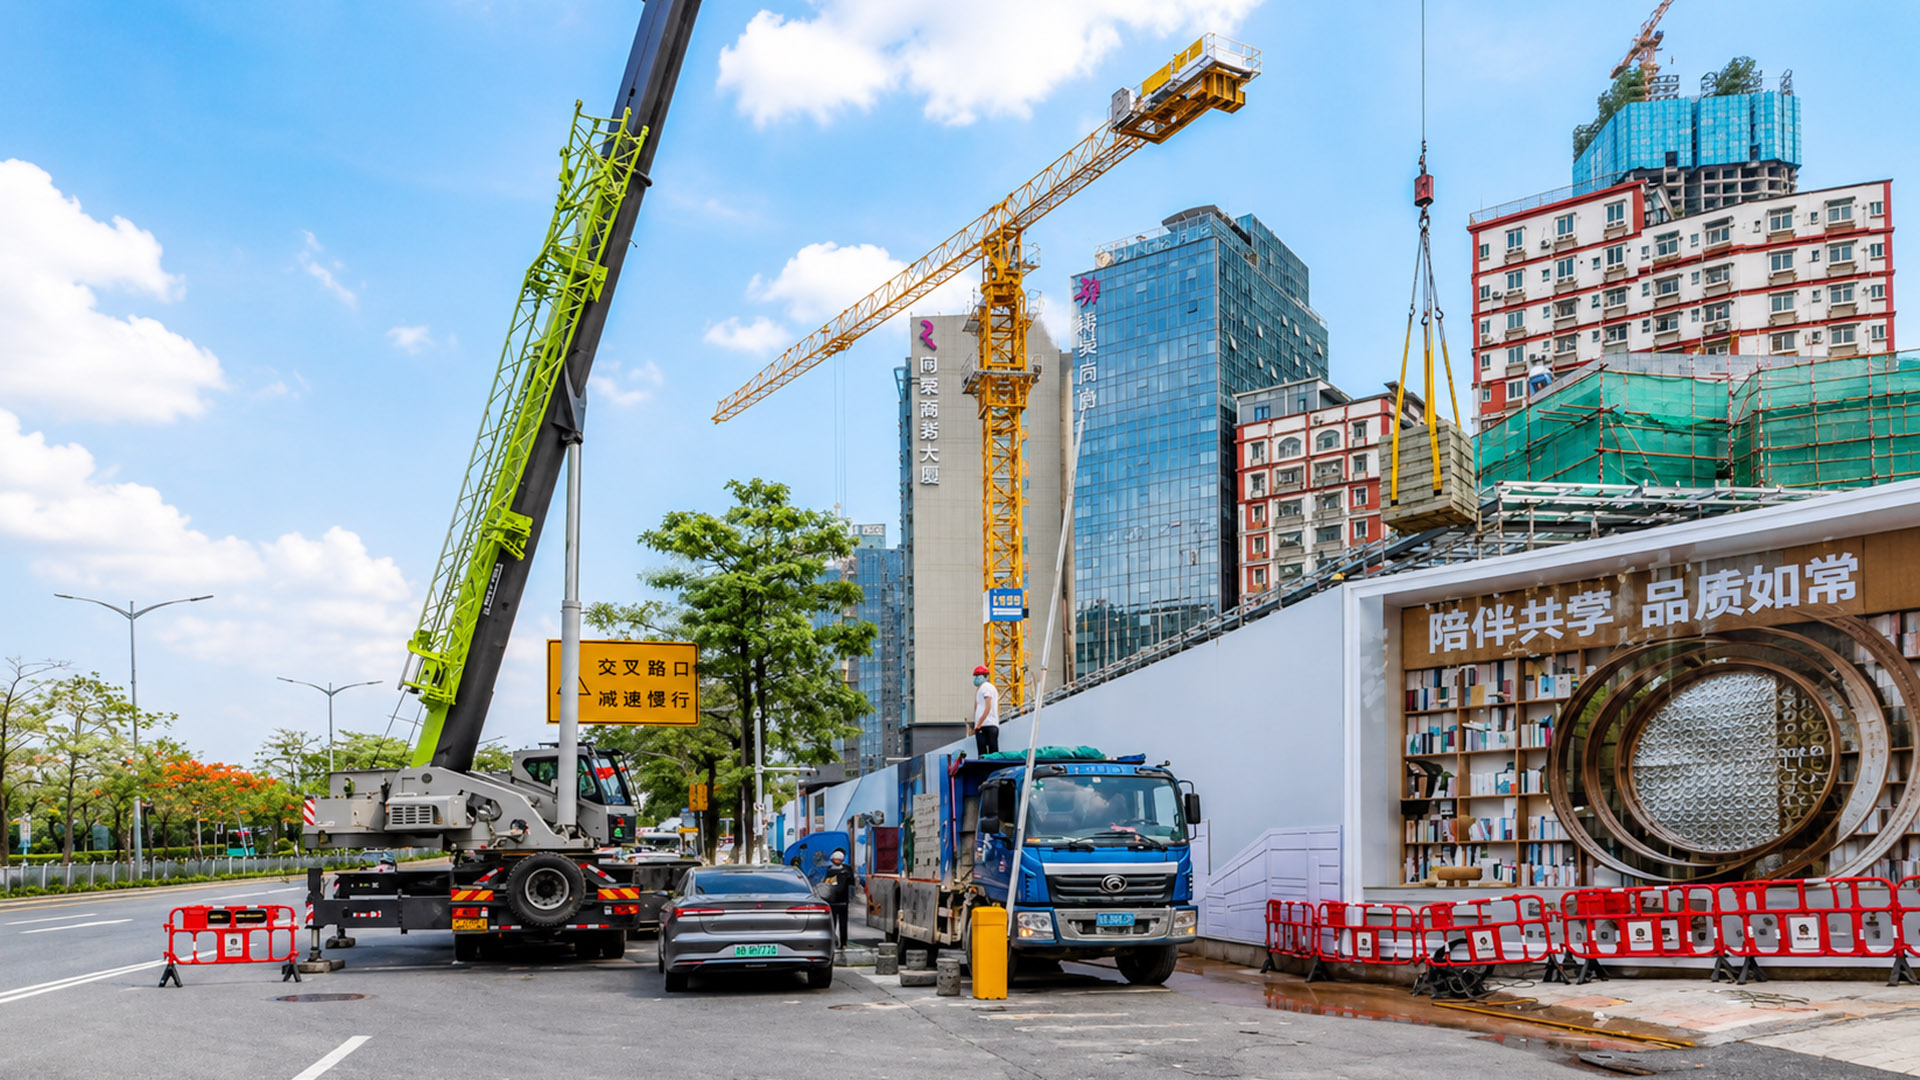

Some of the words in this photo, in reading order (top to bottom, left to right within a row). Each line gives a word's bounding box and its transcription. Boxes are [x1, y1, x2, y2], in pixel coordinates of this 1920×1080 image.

[1642, 552, 1859, 628] 品质如常
[598, 658, 689, 677] 交叉路口
[598, 690, 690, 708] 减速慢行
